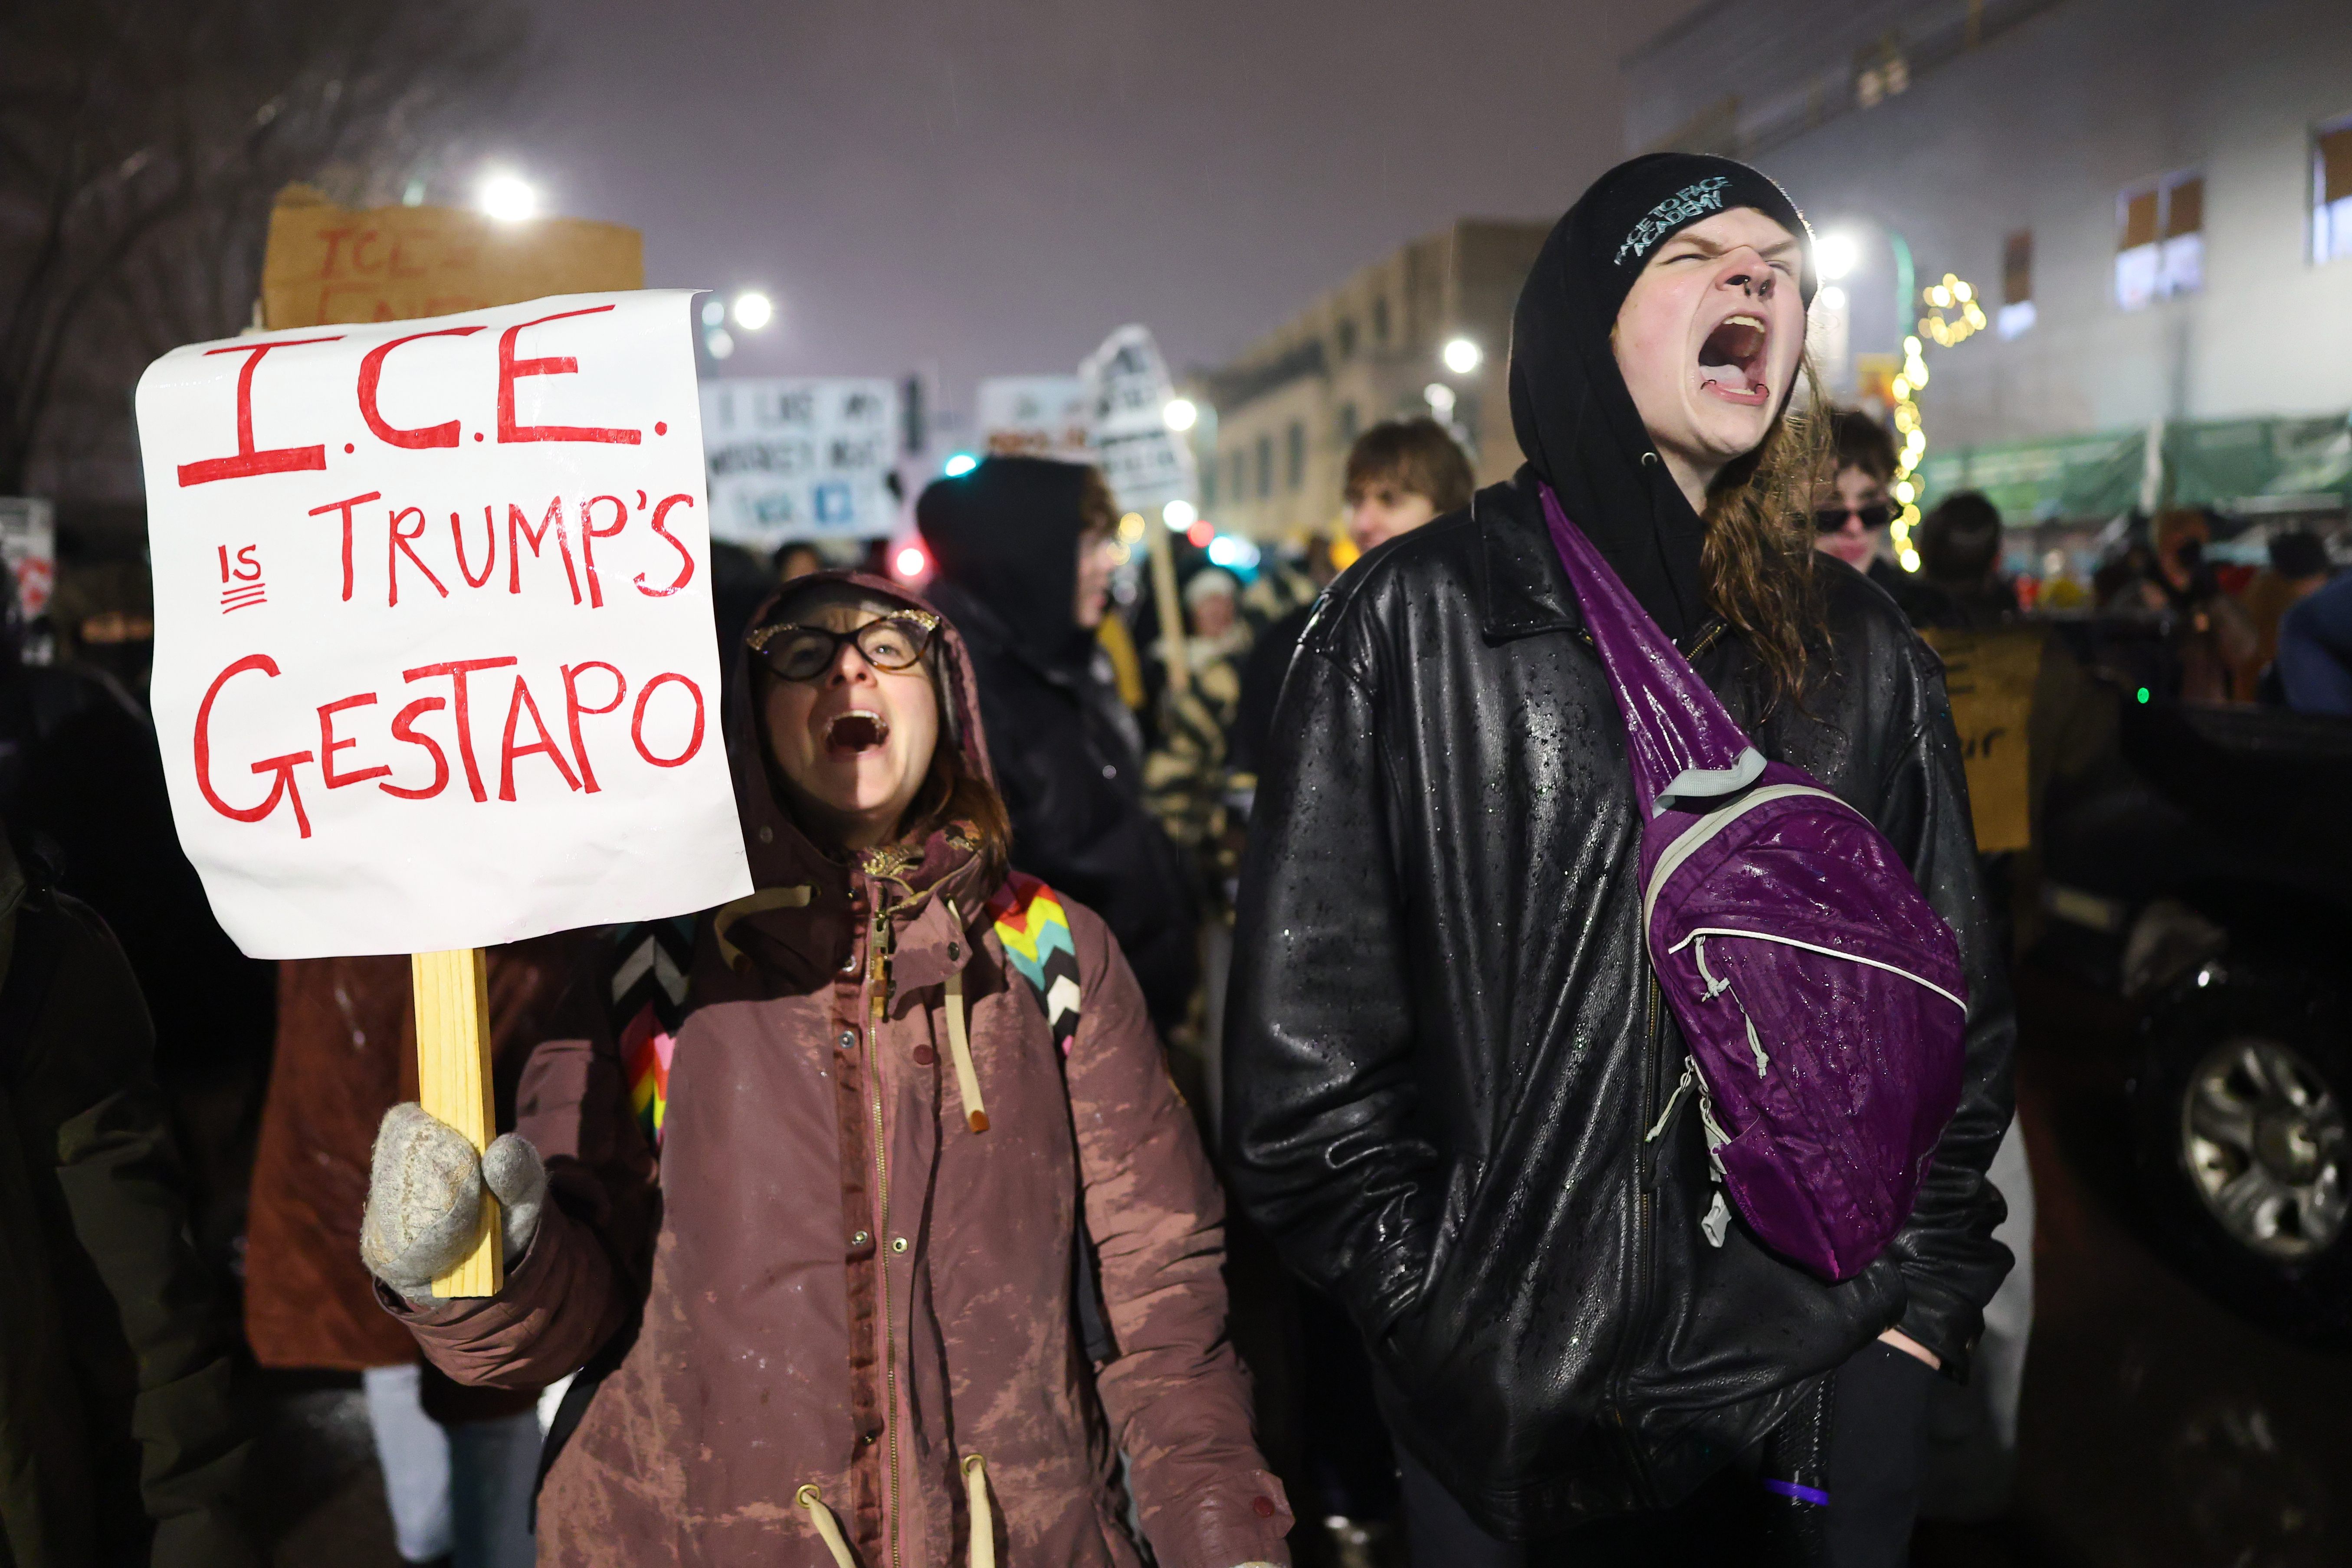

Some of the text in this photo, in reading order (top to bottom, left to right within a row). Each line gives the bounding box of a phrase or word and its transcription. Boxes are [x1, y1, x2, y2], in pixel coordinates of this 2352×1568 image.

[1634, 190, 1723, 257] ACADEMY
[1647, 197, 1680, 217] TO
[1676, 176, 1733, 201] FACE
[317, 226, 436, 281] ICE
[177, 304, 668, 487] I.C.E.
[218, 544, 262, 583] IS
[308, 489, 695, 609] TRUMP'S
[194, 654, 705, 839] GESTAPO
